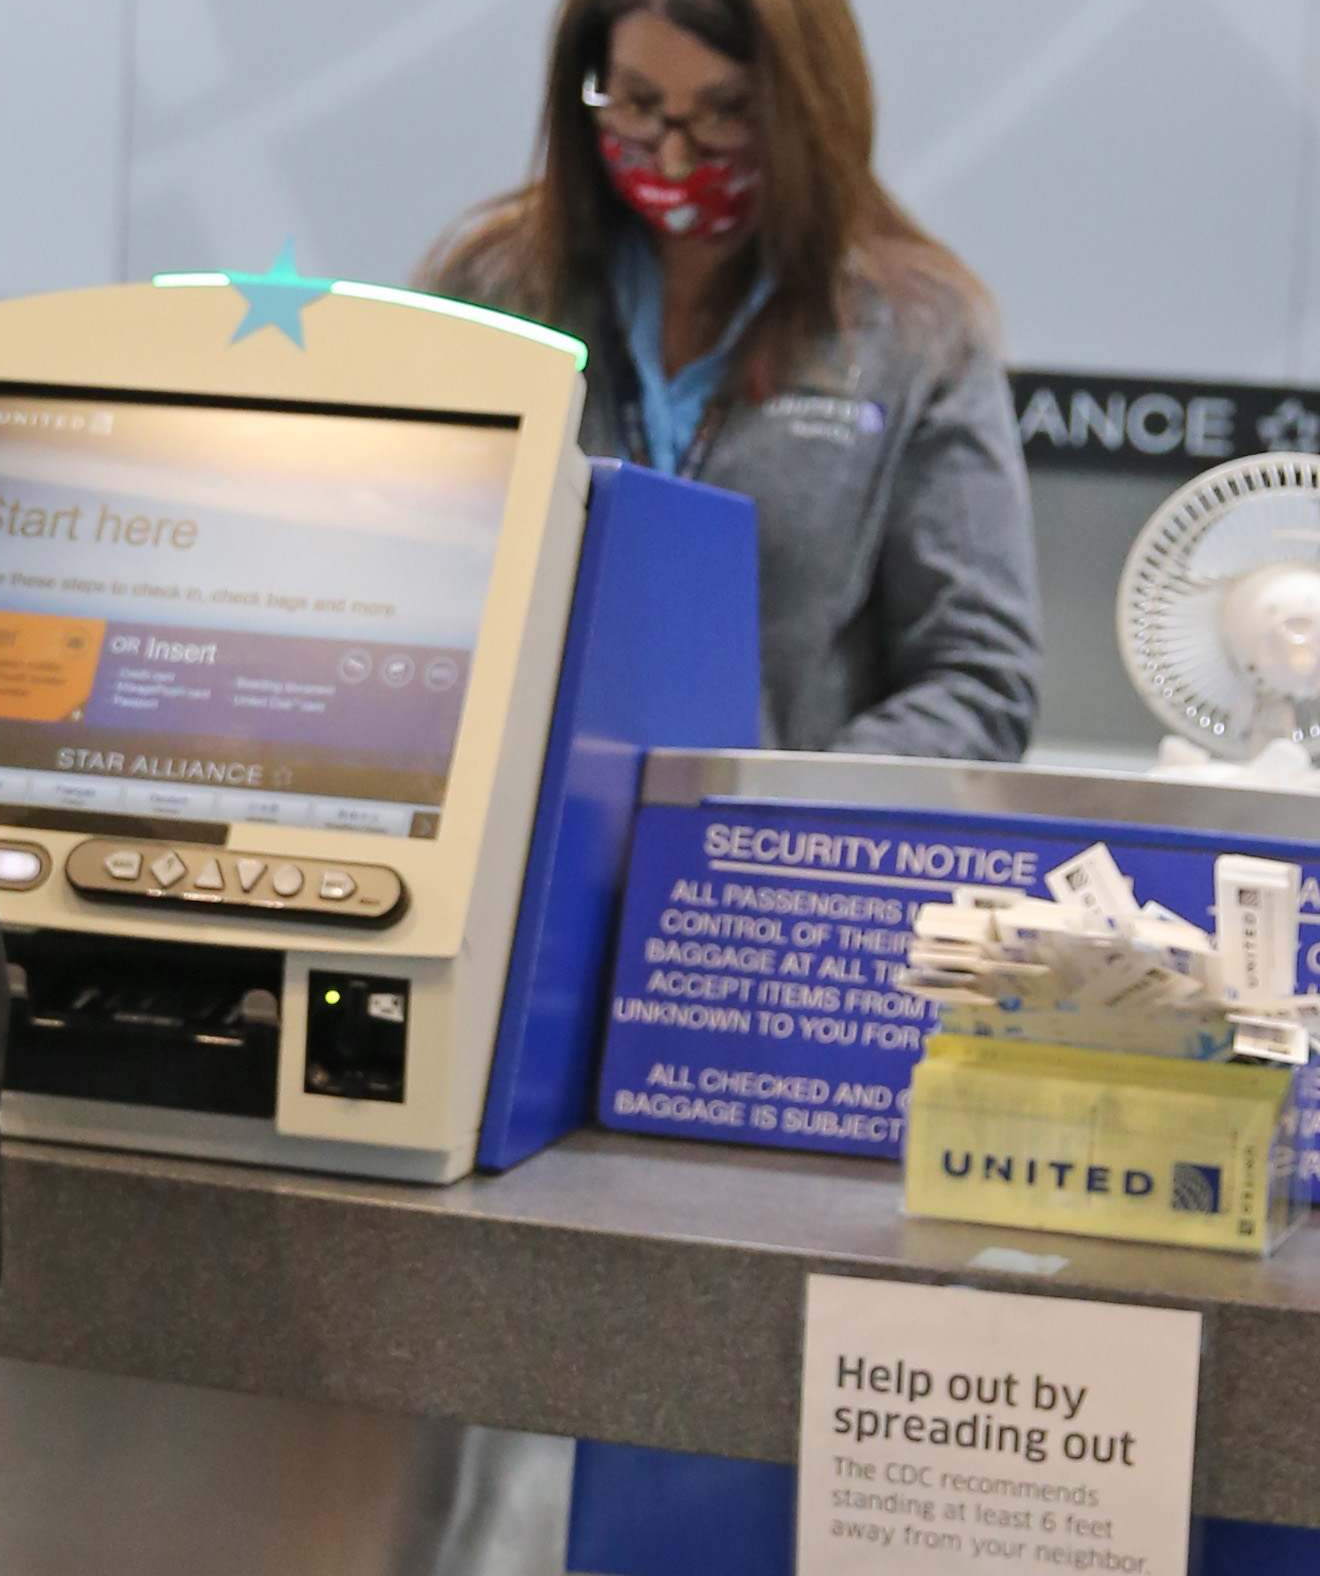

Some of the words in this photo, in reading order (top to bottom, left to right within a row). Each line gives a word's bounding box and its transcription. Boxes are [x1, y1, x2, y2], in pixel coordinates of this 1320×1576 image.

[94, 502, 200, 551] here
[11, 571, 55, 590] these
[61, 574, 105, 595] steps
[112, 578, 127, 595] to
[132, 581, 179, 600] check
[212, 588, 262, 607] check
[266, 592, 308, 613] bags
[313, 595, 346, 614] and
[111, 635, 141, 655] OR
[145, 635, 219, 667] Insert
[56, 746, 125, 773] STAR
[131, 754, 265, 786] ALLIANCE
[702, 822, 892, 872] SECURITY
[895, 840, 1040, 887] NOTICE
[669, 878, 718, 908] ALL
[720, 883, 904, 925] PASSENGERS
[659, 907, 788, 946] CONTROL
[790, 921, 832, 948] OF
[643, 937, 777, 975] BAGGAGE
[779, 952, 817, 976] AT
[816, 955, 868, 984] ALL
[645, 969, 755, 1004] ACCEPT
[756, 979, 842, 1013] ITEMS
[842, 987, 926, 1021] FROM
[611, 996, 753, 1035] UNKNOWN
[756, 1010, 796, 1040] TO
[798, 1016, 858, 1045] YOU
[859, 1022, 922, 1051] FOR
[645, 1061, 696, 1091] ALL
[697, 1067, 831, 1105] CHECKED
[832, 1081, 894, 1112] AND
[612, 1088, 747, 1126] BAGGAGE
[748, 1102, 779, 1131] IS
[780, 1106, 907, 1143] SUBJECT
[941, 1148, 1156, 1198] UNITED
[835, 1354, 933, 1403] Help
[946, 1372, 1020, 1408] out
[1032, 1374, 1089, 1421] by
[833, 1405, 1049, 1464] spreading
[1062, 1429, 1136, 1467] out
[833, 1455, 877, 1481] The
[883, 1461, 934, 1488] CDC
[939, 1470, 1100, 1509] recommends
[831, 1486, 936, 1523] standing
[942, 1501, 967, 1523] at
[975, 1502, 1033, 1531] least
[1039, 1511, 1057, 1534] 6
[1063, 1514, 1115, 1541] feet
[830, 1519, 895, 1548] away
[902, 1524, 963, 1551] from
[971, 1537, 1028, 1561] your
[1033, 1542, 1153, 1576] neighbor.
